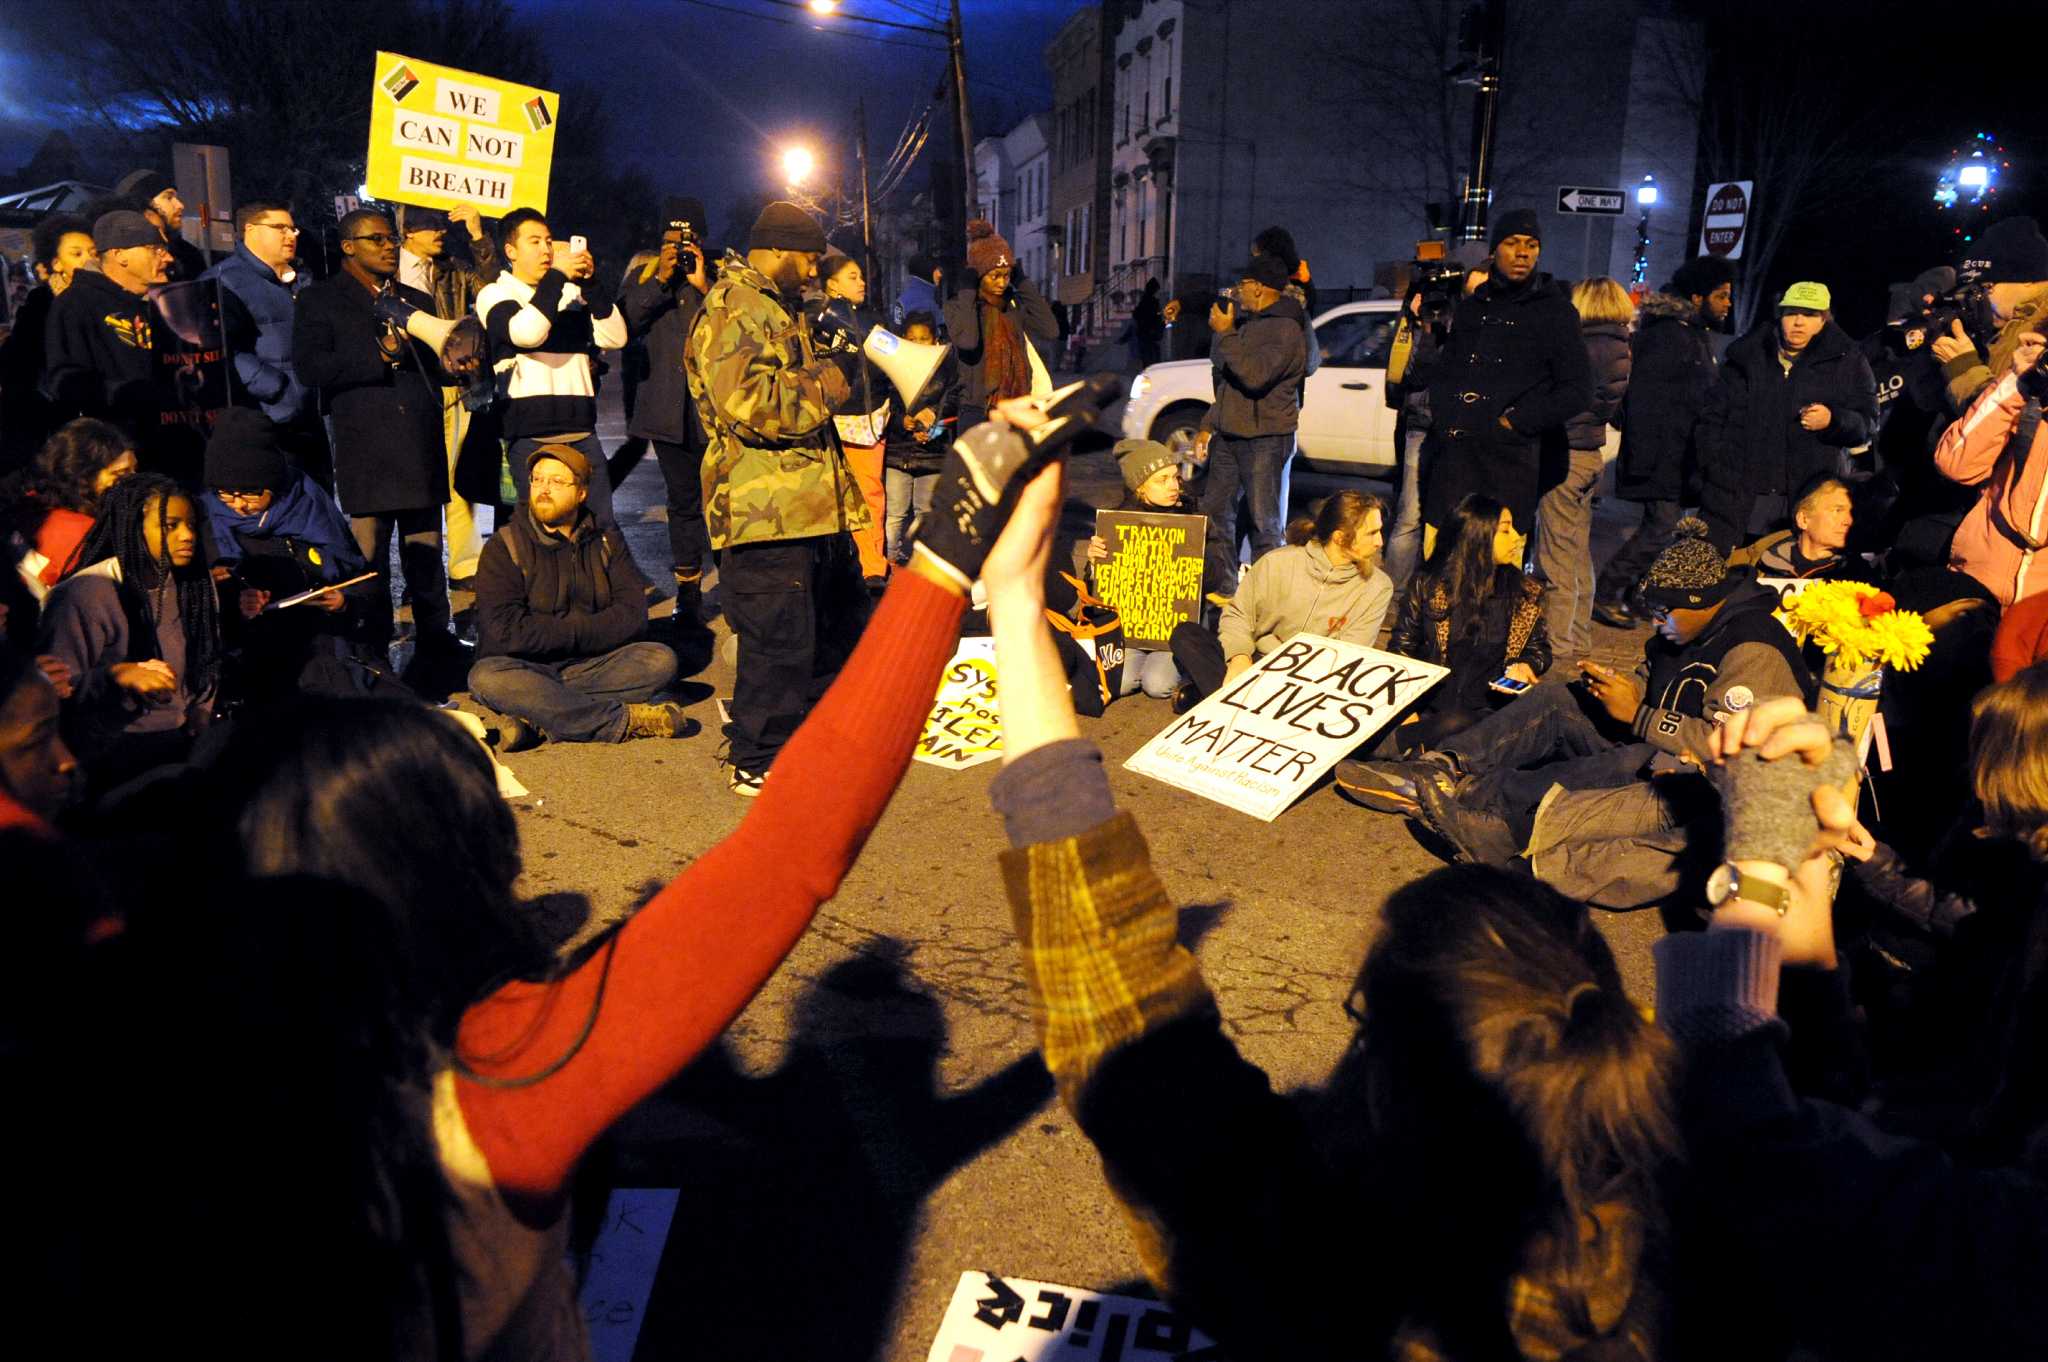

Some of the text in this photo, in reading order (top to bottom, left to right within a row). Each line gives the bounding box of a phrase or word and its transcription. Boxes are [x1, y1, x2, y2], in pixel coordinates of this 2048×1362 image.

[449, 90, 487, 117] WE
[400, 120, 518, 159] CAN NOT
[408, 166, 507, 199] BREATH
[1578, 195, 1618, 208] ONE WAY
[1712, 197, 1744, 211] DO NOT
[1710, 231, 1735, 244] ENTER
[1115, 525, 1186, 544] TRAYVON
[1122, 539, 1174, 557] MARTIN
[1152, 580, 1199, 601] BROWN
[1146, 596, 1175, 613] RICE
[947, 663, 998, 699] SYS
[1260, 640, 1429, 706] BLACK
[1220, 673, 1374, 740] LIVES
[1164, 715, 1316, 782] MATTER
